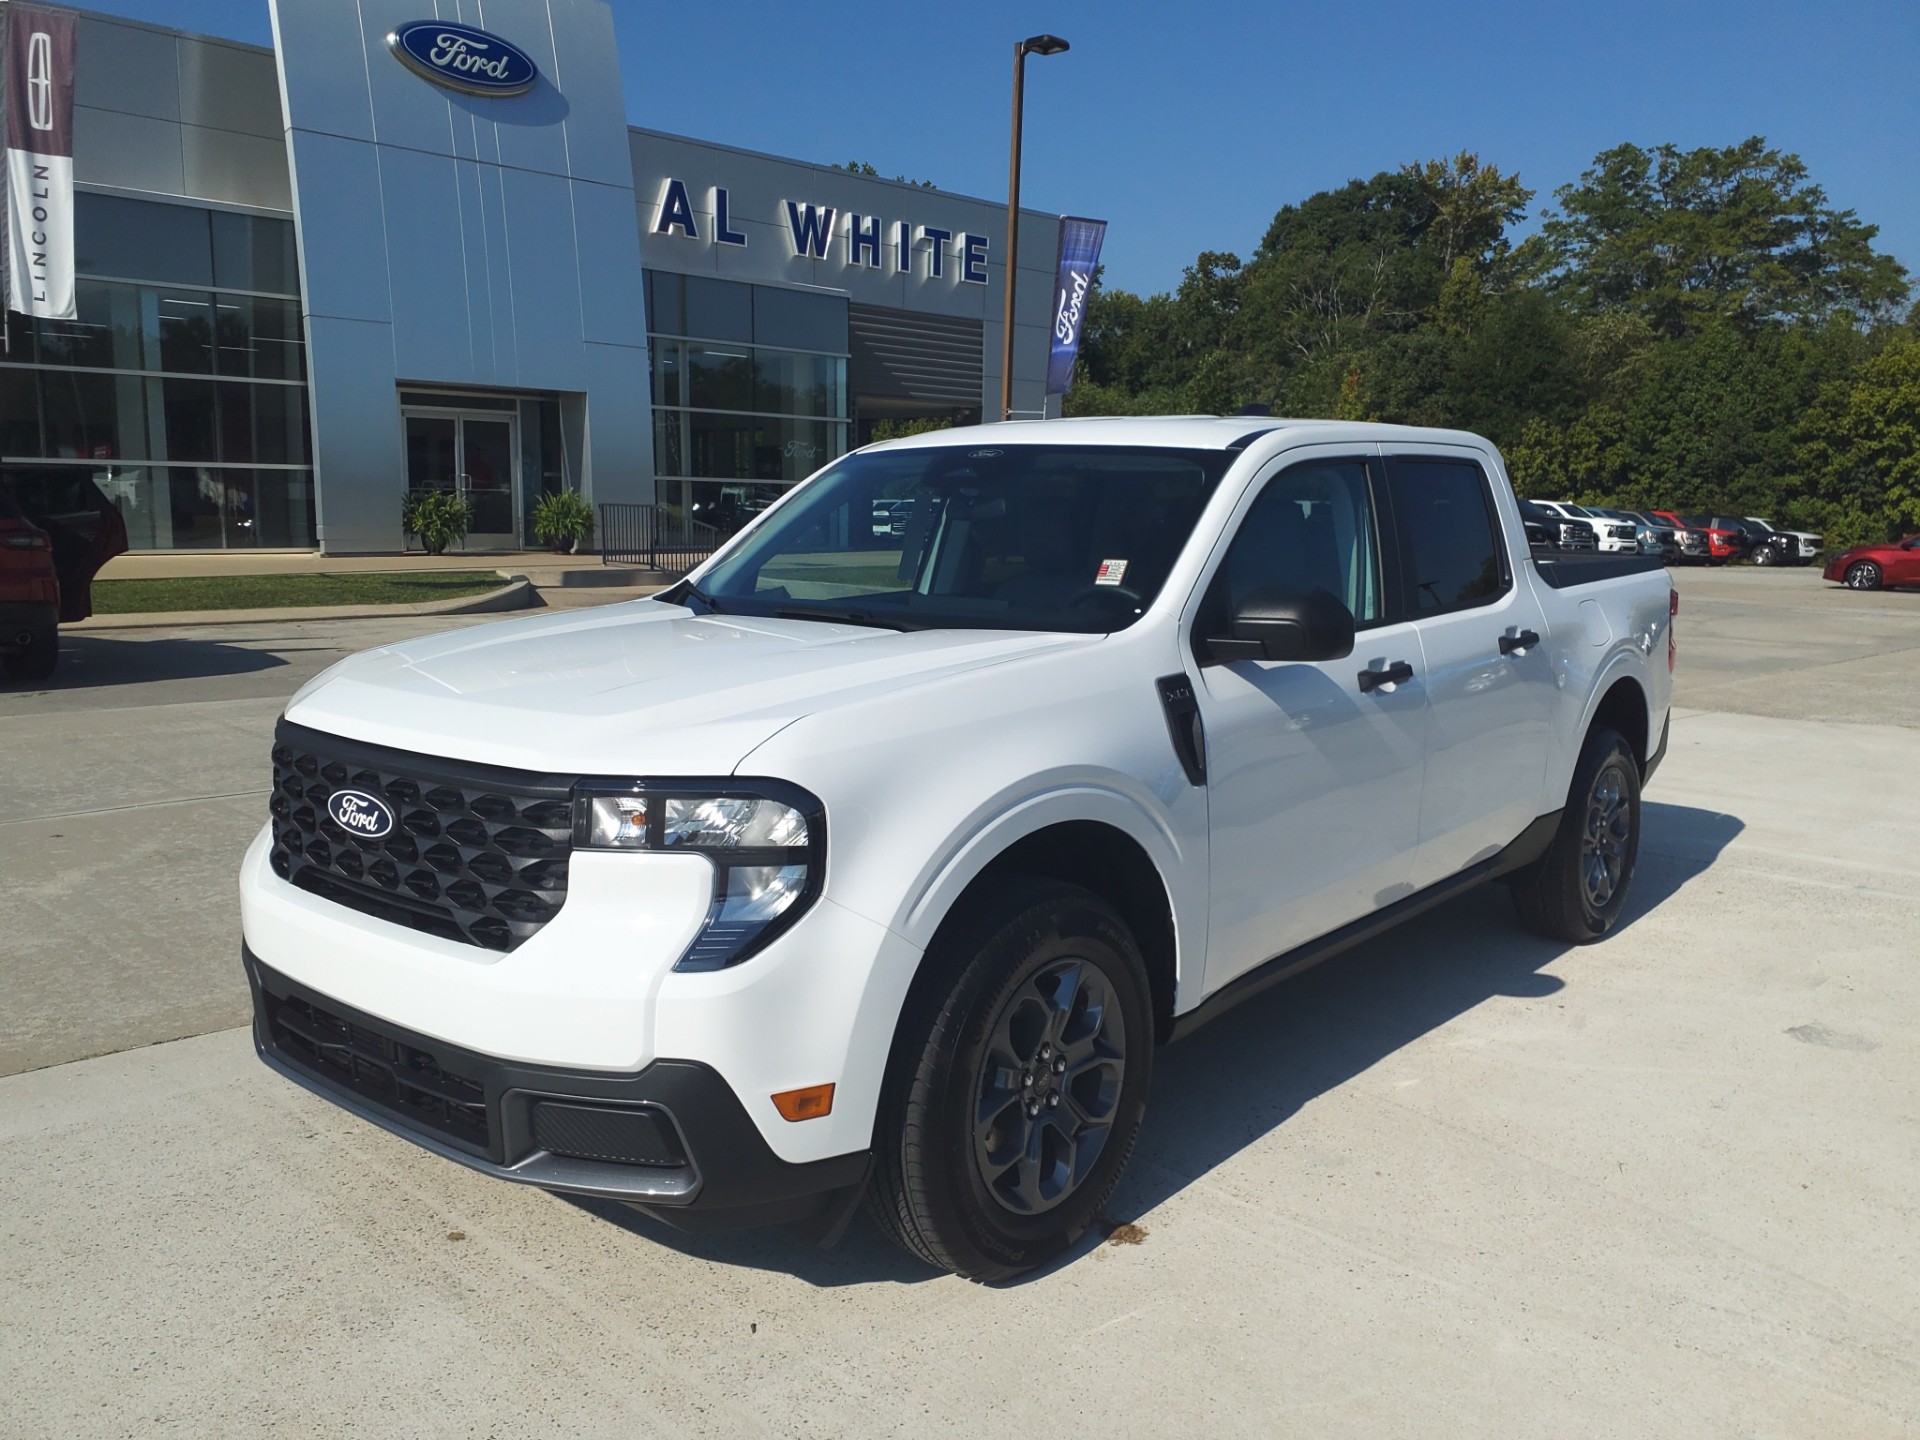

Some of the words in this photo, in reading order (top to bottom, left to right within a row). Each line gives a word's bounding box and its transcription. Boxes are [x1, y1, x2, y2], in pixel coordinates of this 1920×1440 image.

[430, 33, 509, 79] Ford
[32, 165, 49, 302] LINCOLN
[650, 177, 748, 248] AL
[783, 199, 990, 286] WHITE
[1056, 270, 1089, 345] Ford
[784, 440, 816, 459] Ford
[338, 795, 379, 831] Ford
